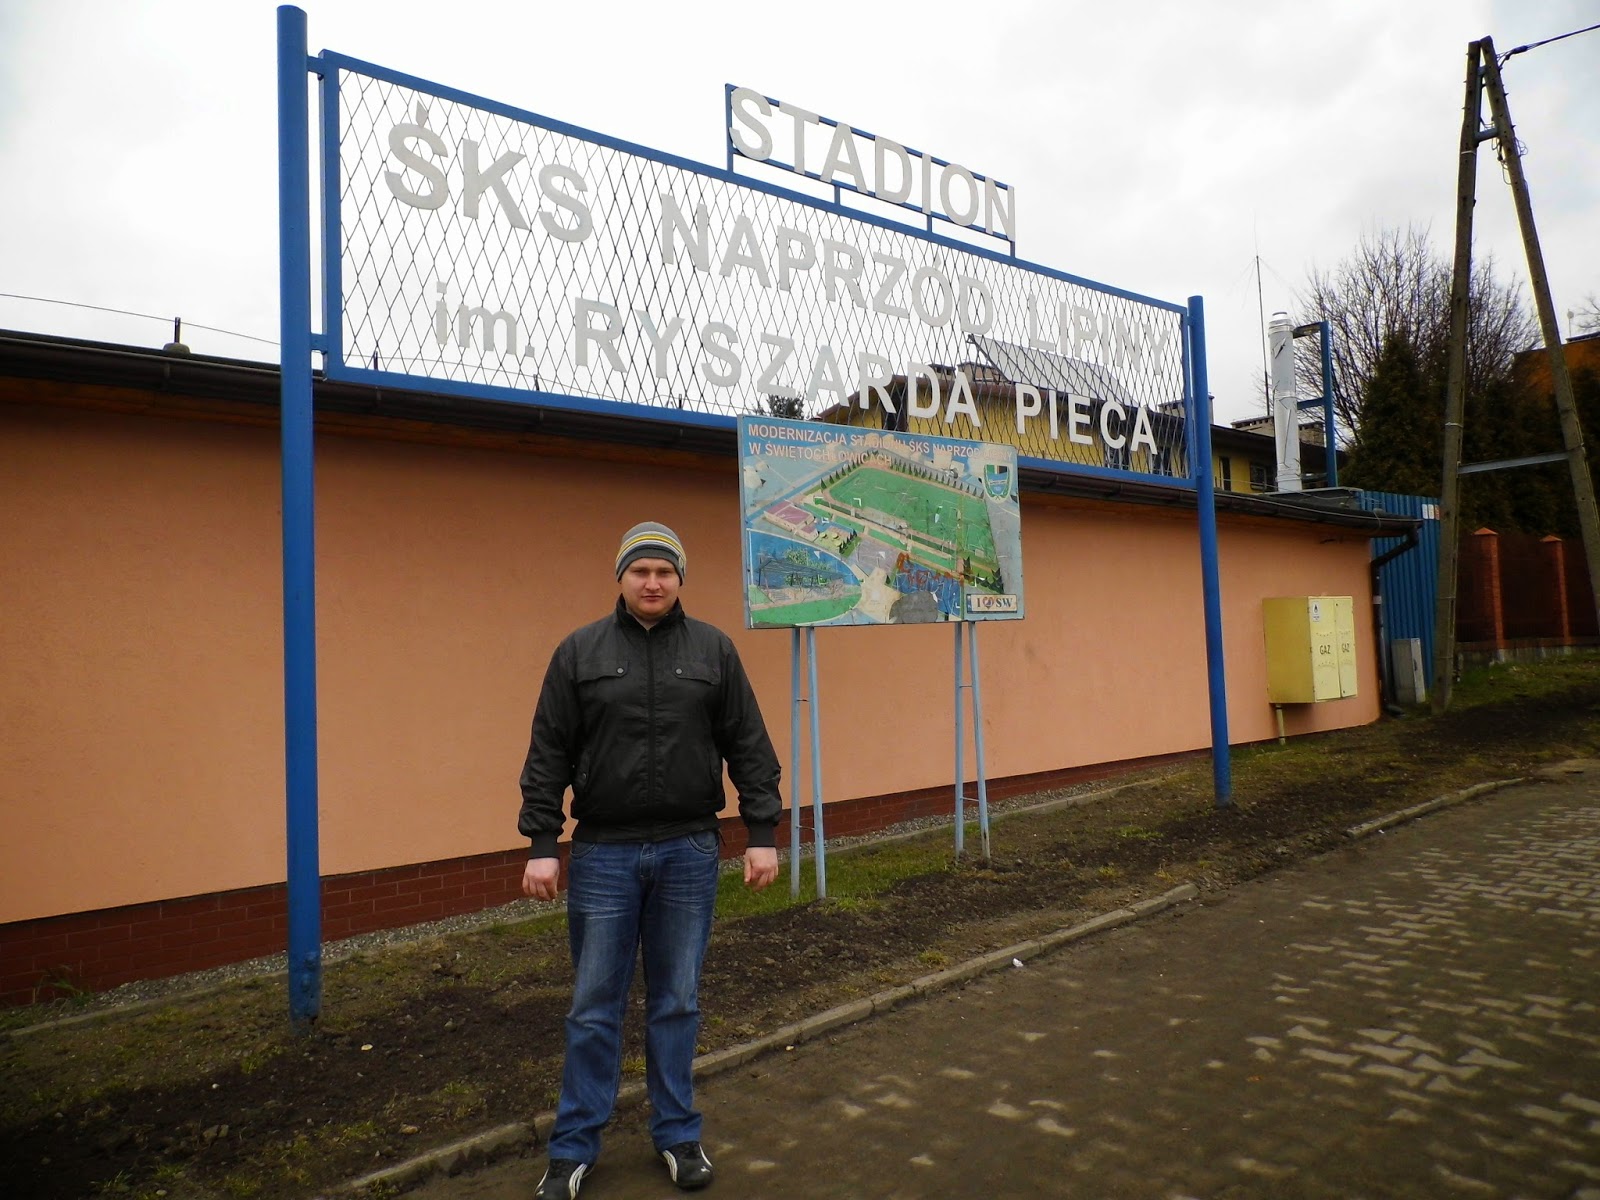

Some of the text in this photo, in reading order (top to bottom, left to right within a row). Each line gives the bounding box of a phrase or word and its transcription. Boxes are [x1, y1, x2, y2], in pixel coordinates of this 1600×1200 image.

[728, 86, 1015, 241] STADION
[384, 100, 1169, 376] ŚKS NAPRZÓD LIPINY
[435, 281, 1158, 455] im. RYSZARDA PIECA
[748, 424, 847, 446] MODERNIZACJA
[909, 438, 930, 454] ŚKS
[748, 442, 761, 455] W
[1319, 644, 1331, 655] GAZ
[1341, 643, 1350, 653] GAZ
